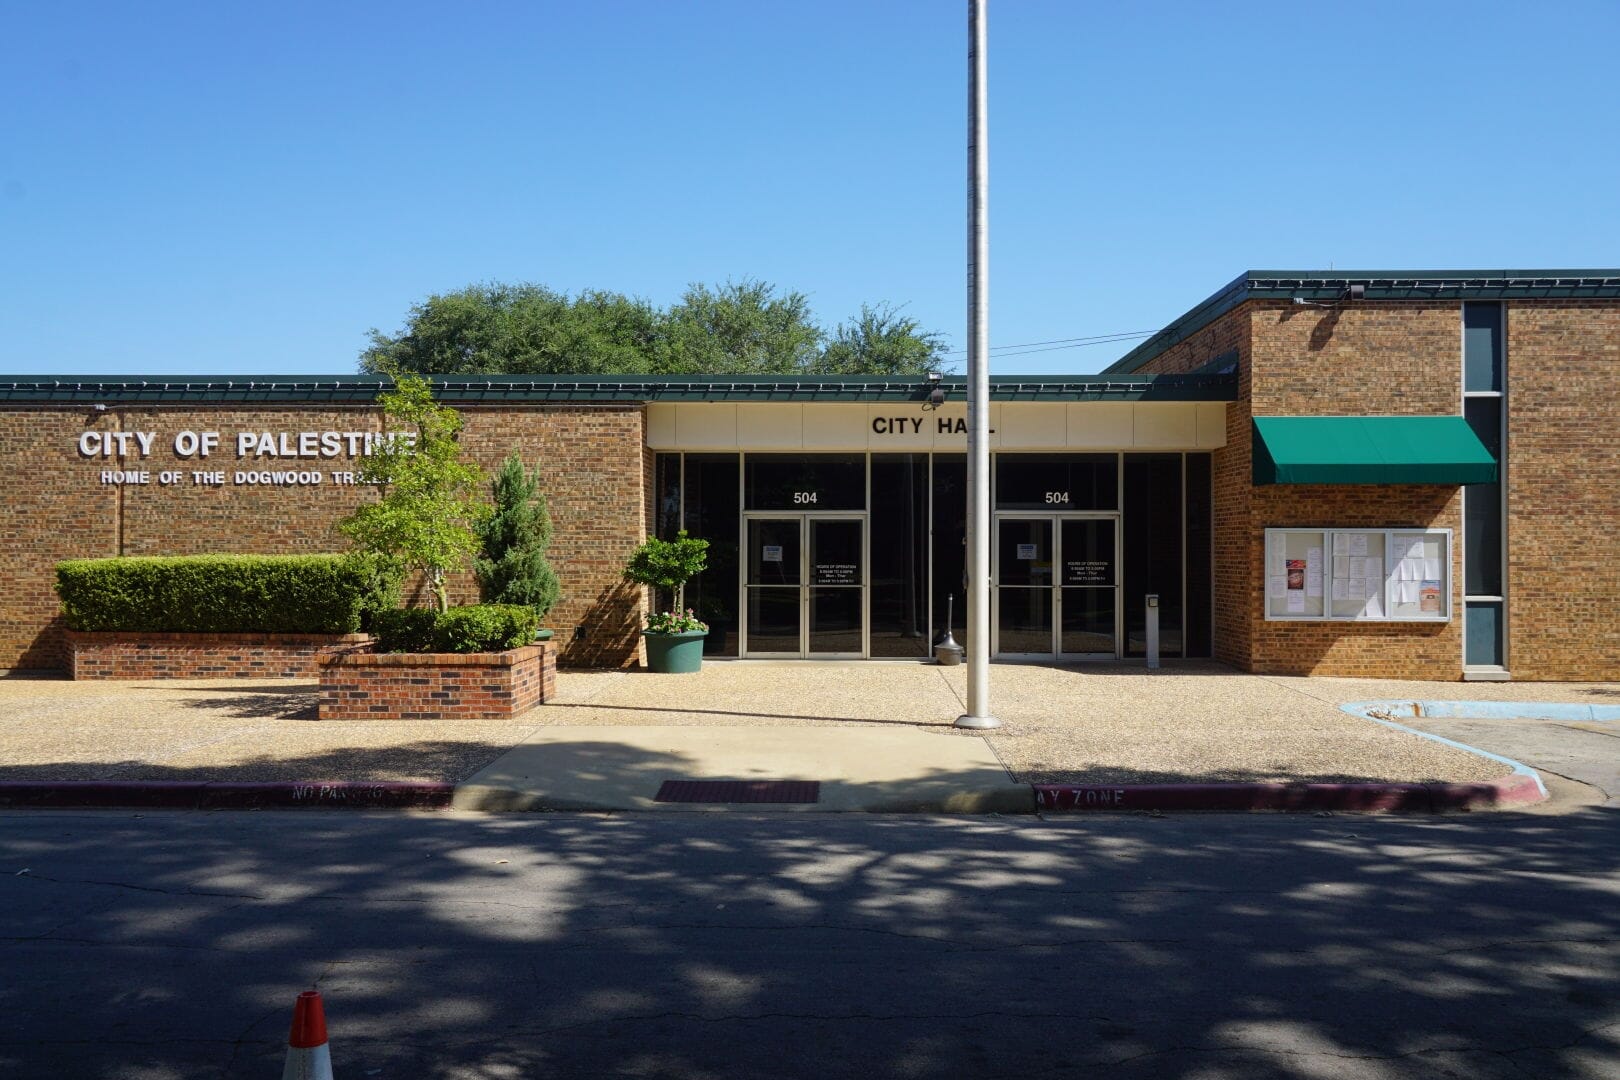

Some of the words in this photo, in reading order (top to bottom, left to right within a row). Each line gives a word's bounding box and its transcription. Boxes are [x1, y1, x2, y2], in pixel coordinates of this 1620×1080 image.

[873, 417, 923, 434] CITY
[938, 417, 995, 434] HA
[79, 431, 156, 456] CITY
[174, 431, 219, 456] OF
[101, 471, 150, 484] HOME
[159, 471, 183, 484] OF
[192, 471, 225, 484] THE
[235, 471, 322, 484] DOGWOOD
[793, 492, 818, 504] 504
[1045, 491, 1070, 504] 504
[292, 785, 314, 800] NO
[1072, 790, 1124, 805] ZONE
